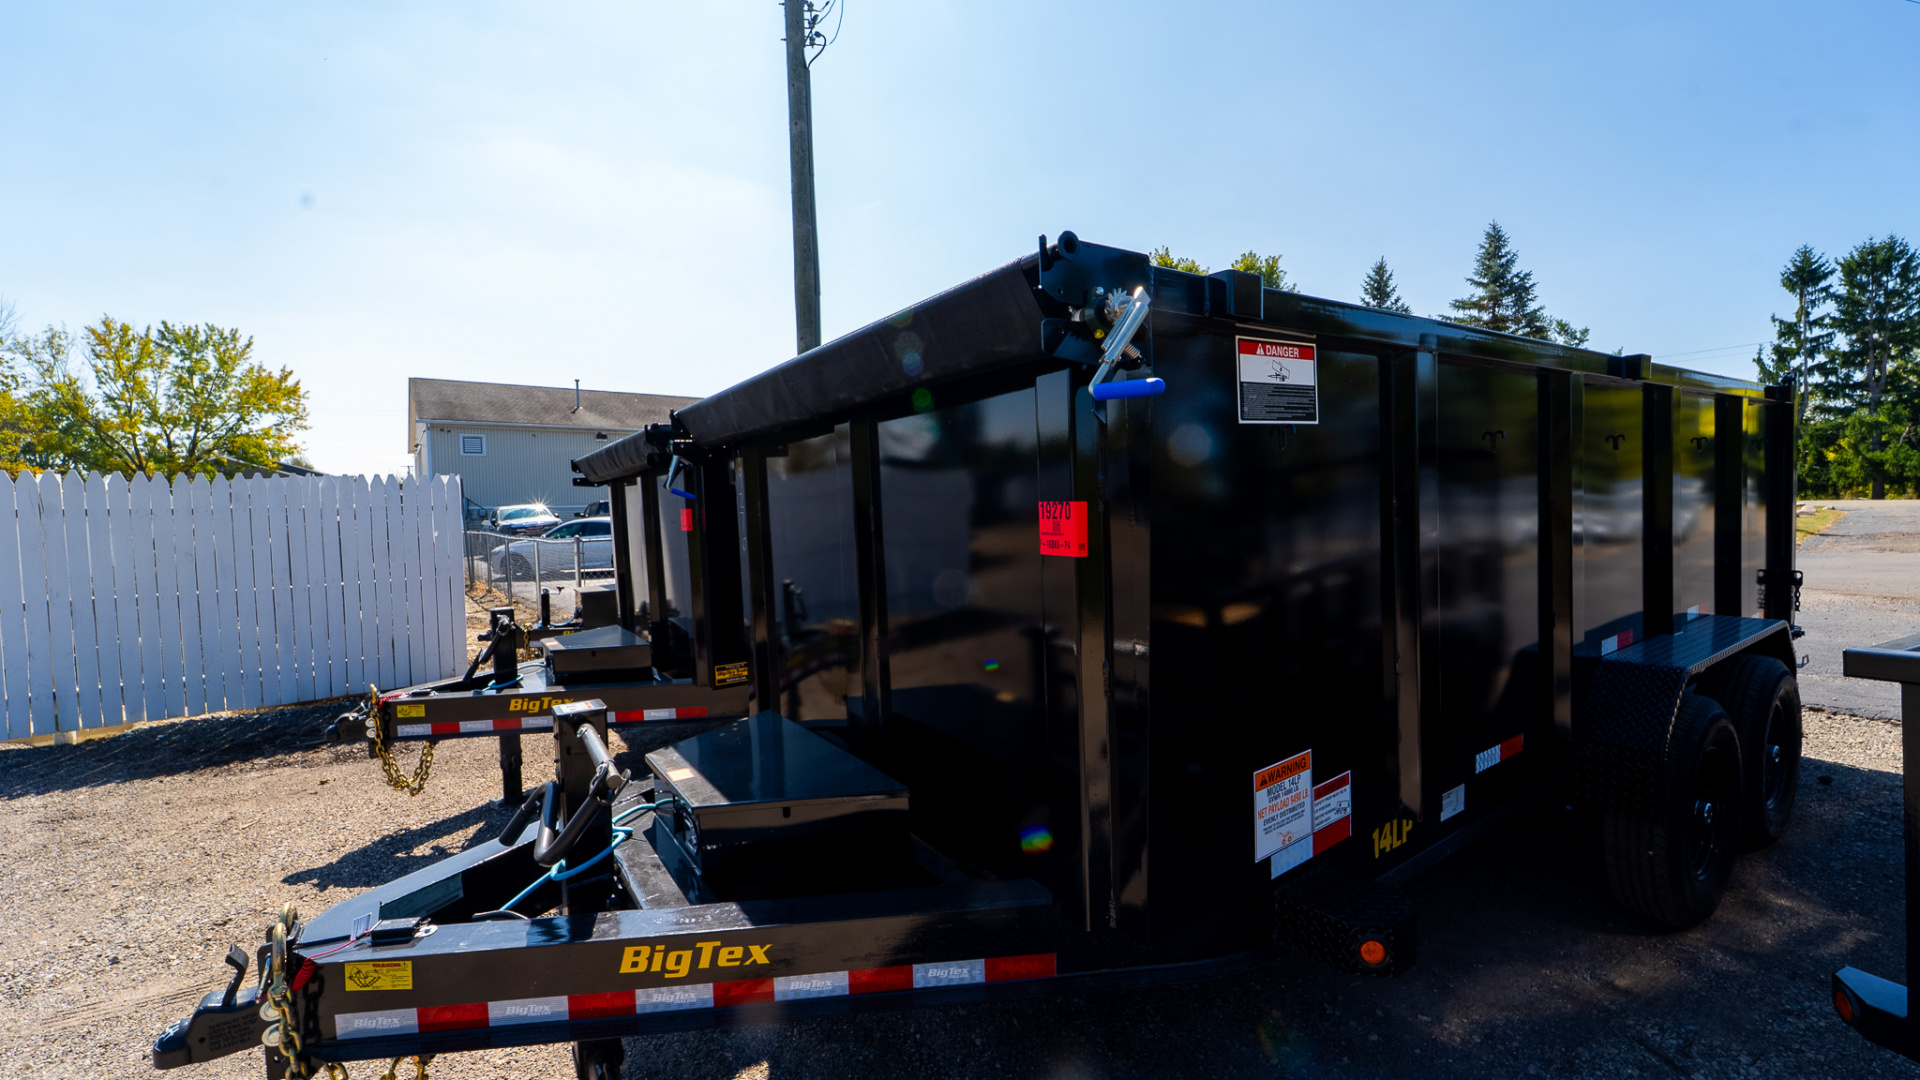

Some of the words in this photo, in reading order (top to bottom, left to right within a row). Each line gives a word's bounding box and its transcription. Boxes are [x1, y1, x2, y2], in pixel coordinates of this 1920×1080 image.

[1265, 344, 1300, 358] DANGER
[1040, 500, 1071, 520] 19270
[1267, 757, 1307, 782] WARNING
[1267, 782, 1286, 797] MODEL
[1288, 774, 1301, 788] 14LP
[1323, 777, 1346, 795] DANGER
[1257, 807, 1268, 820] NET
[1268, 797, 1289, 815] PAYLOAD
[1263, 814, 1279, 827] EVENLY
[1279, 801, 1306, 818] DISTRIBUTED
[619, 940, 773, 979] BigTex
[928, 966, 969, 978] BigTex
[789, 979, 833, 991] BigTex
[652, 991, 697, 1003] BigTex
[505, 1003, 552, 1016] BigTex
[353, 1016, 401, 1029] BigTex
